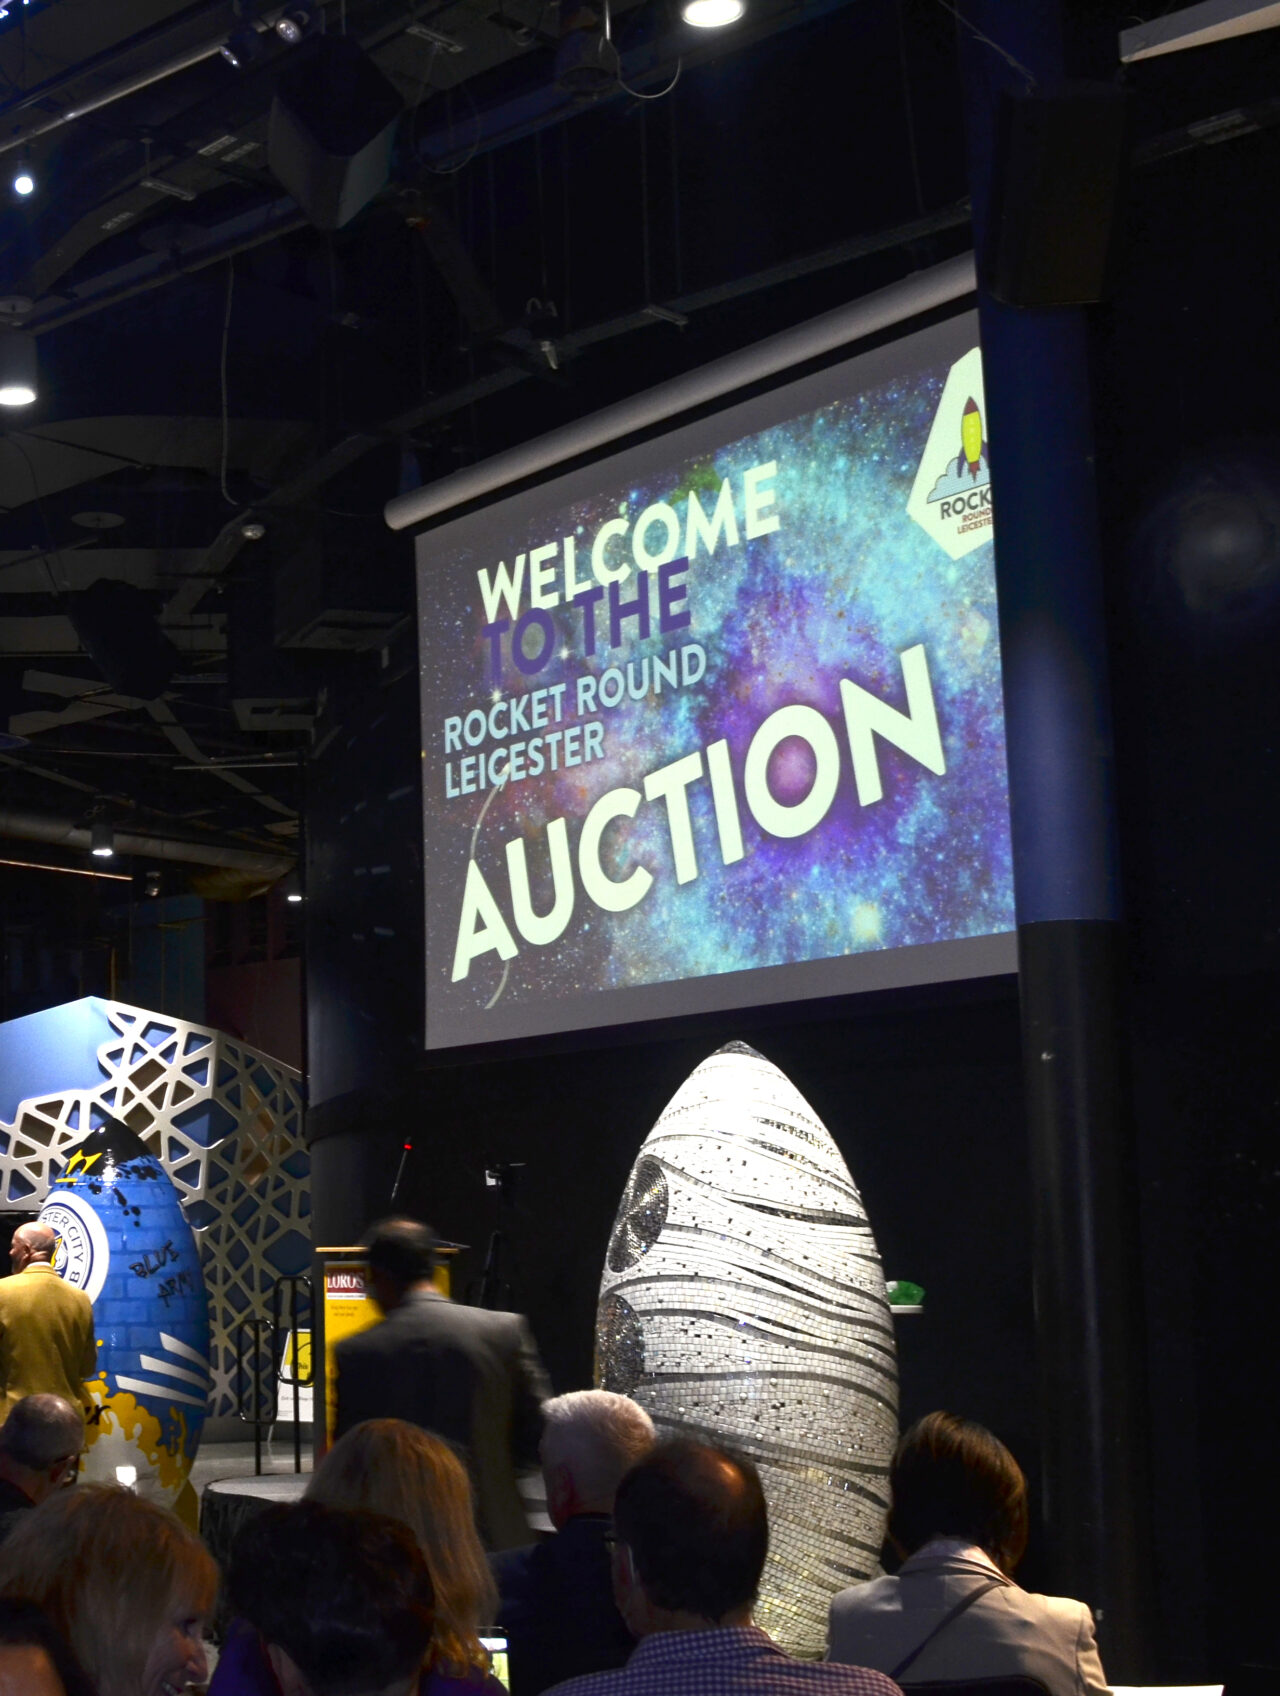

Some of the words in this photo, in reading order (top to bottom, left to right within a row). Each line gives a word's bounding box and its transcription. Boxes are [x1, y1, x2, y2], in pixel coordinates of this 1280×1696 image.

[477, 459, 782, 624] WELCOME
[940, 487, 992, 520] ROCK
[957, 516, 993, 534] LEICESTE
[481, 606, 556, 688] TO
[574, 555, 692, 658] THE
[444, 682, 567, 754] ROCKET
[577, 643, 708, 716] ROUND
[445, 721, 605, 799] LEICESTER
[450, 642, 948, 983] AUCTION
[67, 1226, 84, 1262] CITY
